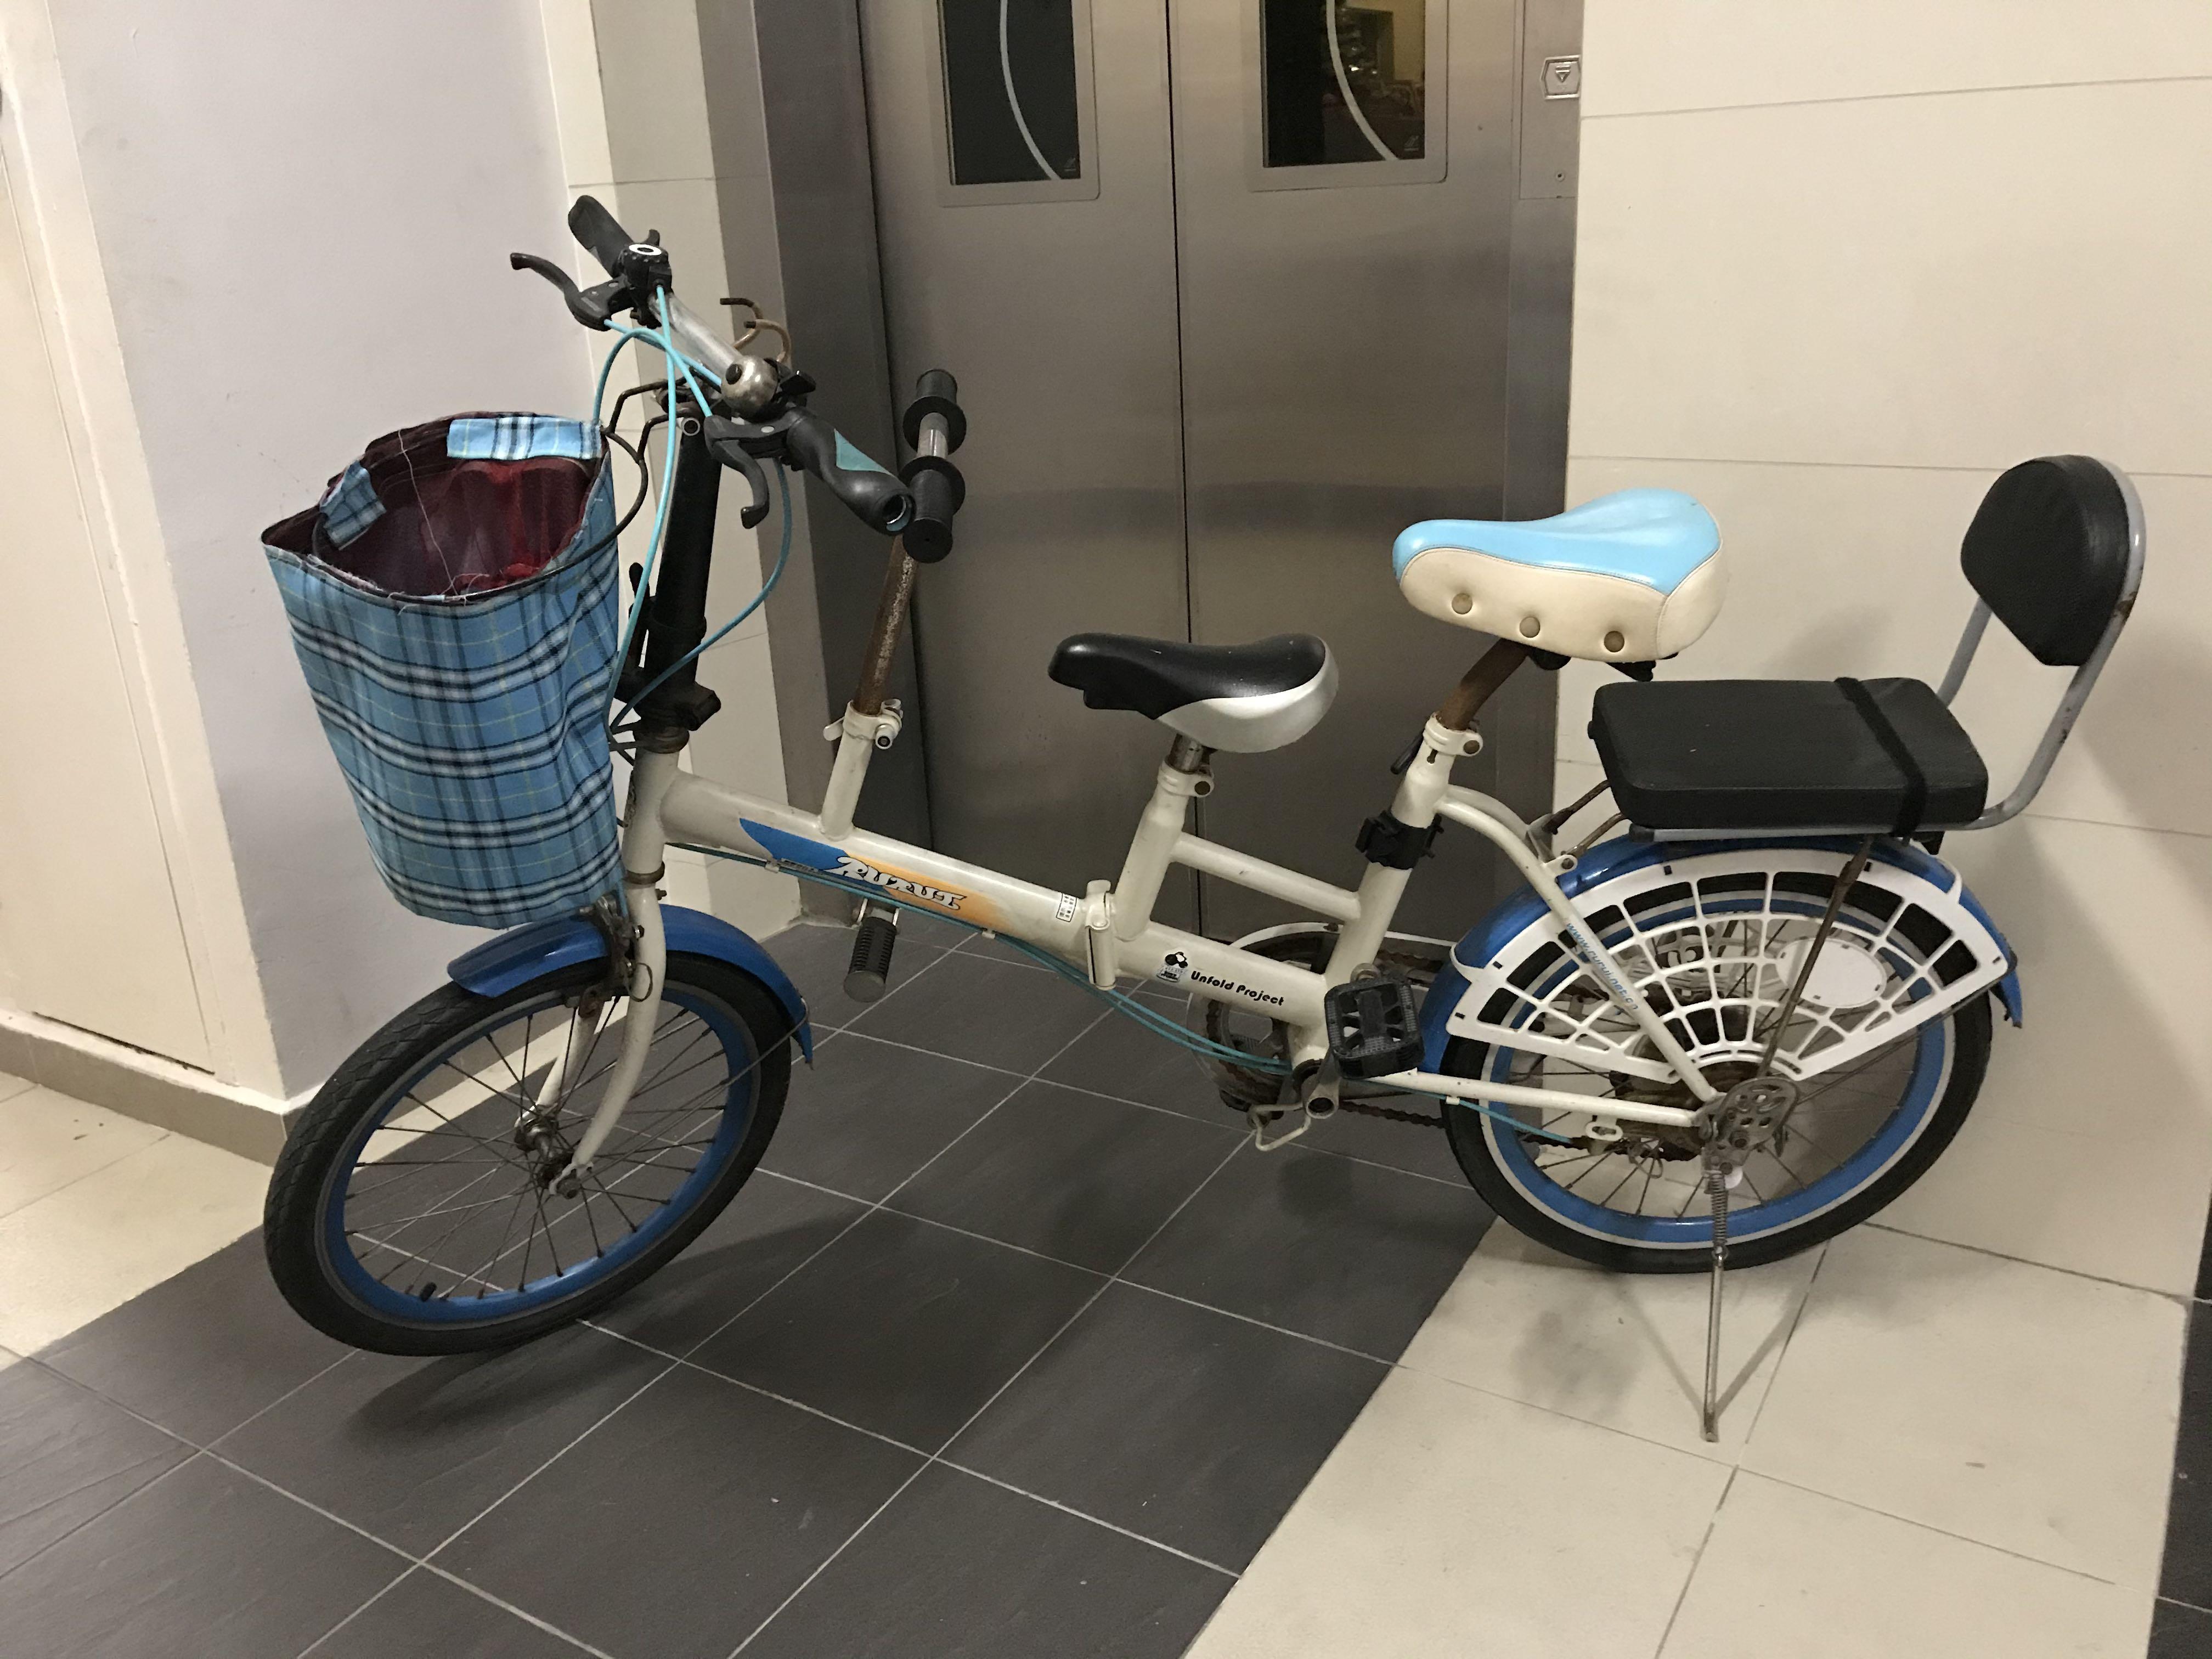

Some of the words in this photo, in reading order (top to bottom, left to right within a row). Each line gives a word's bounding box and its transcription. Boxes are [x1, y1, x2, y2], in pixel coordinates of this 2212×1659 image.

[823, 856, 967, 910] RURUI
[1191, 970, 1234, 990] Unfold
[1235, 985, 1284, 1006] Project
